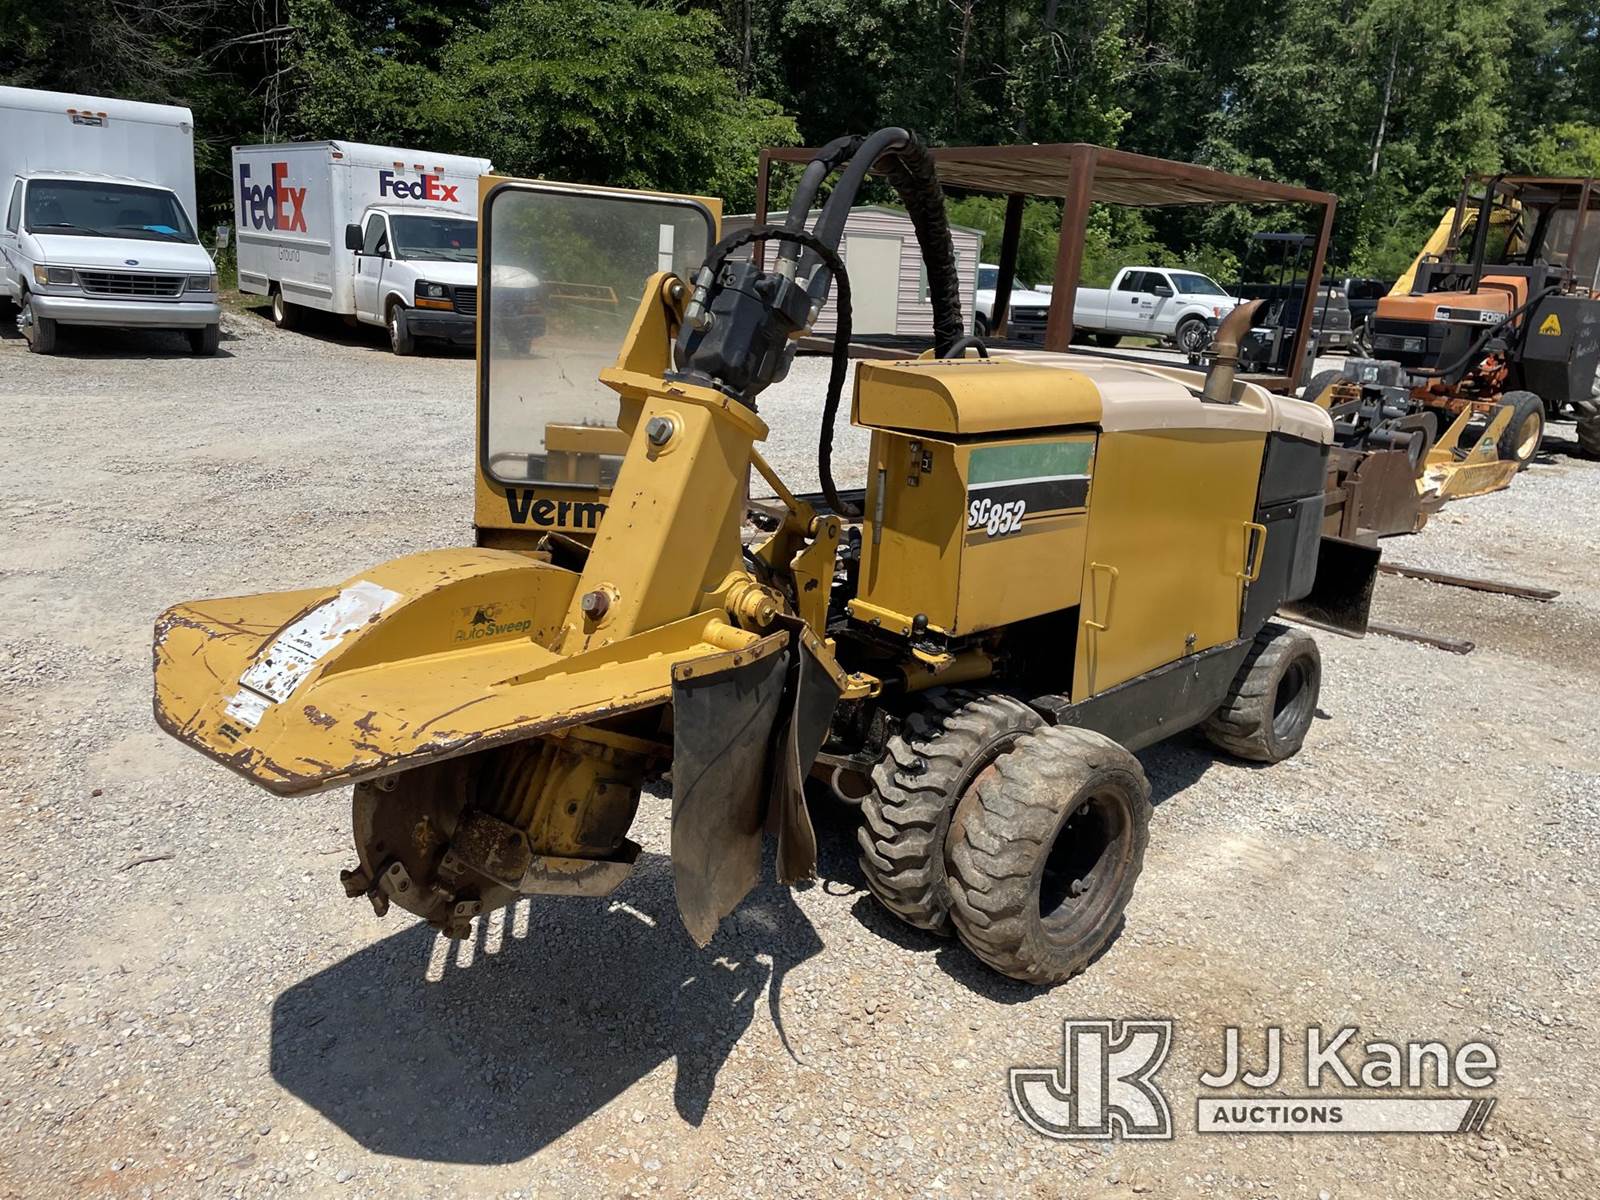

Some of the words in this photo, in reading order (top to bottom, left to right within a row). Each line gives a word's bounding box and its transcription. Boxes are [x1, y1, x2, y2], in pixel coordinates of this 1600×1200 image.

[240, 163, 307, 233] FedEx
[379, 170, 459, 202] FedEx
[968, 498, 1026, 536] SC852
